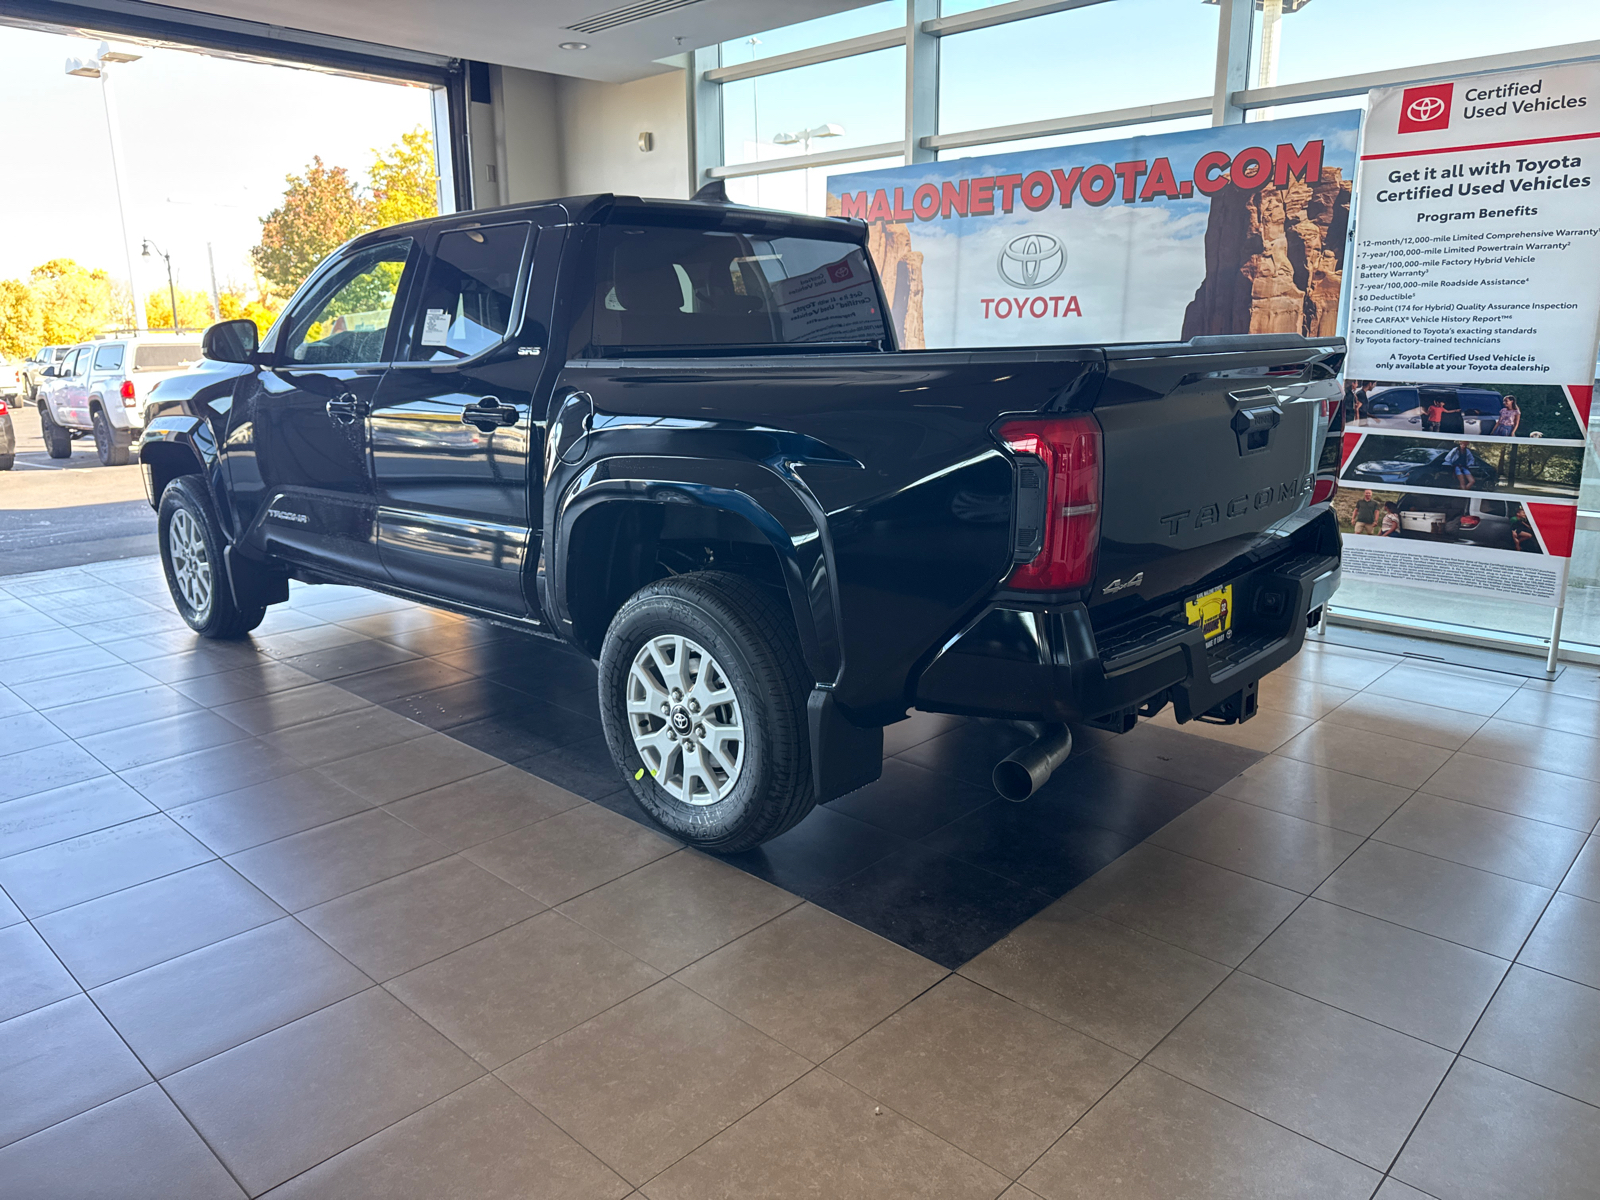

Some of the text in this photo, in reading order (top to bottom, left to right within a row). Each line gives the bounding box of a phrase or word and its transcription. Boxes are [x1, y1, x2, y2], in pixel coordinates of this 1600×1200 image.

[1465, 79, 1542, 102] Certified
[1463, 95, 1587, 119] Used Vehicles
[1388, 156, 1582, 184] Get it all with Toyota
[840, 139, 1325, 225] MALONETOYOTA.COM
[1376, 174, 1591, 203] Certified Used Vehicles
[1417, 206, 1538, 224] Program Benefits
[1362, 234, 1451, 247] 12-month/12,000-mile
[1452, 232, 1484, 242] Limited
[1485, 230, 1554, 240] Comprehensive
[1362, 247, 1442, 260] 7-year/100,000-mile
[1443, 245, 1475, 254] Limited
[1477, 243, 1524, 252] Powertrain
[1360, 255, 1536, 271] 8-year/100,000-mile Factory Hybrid Vehicle
[1360, 271, 1388, 279] Battery
[1359, 280, 1439, 291] 7-year/100,000-mile
[1440, 279, 1479, 287] Roadside
[1358, 294, 1368, 302] $0
[980, 296, 1082, 319] TOYOTA
[1394, 304, 1411, 313] (174
[1424, 303, 1455, 313] Hybrid)
[1456, 302, 1486, 312] Quality
[1532, 302, 1578, 311] Inspection
[1441, 315, 1471, 324] History
[1423, 327, 1455, 336] Toyota's
[1456, 327, 1492, 336] exacting
[1355, 336, 1364, 345] by
[1366, 336, 1391, 345] Toyota
[1392, 336, 1452, 345] factory-trained
[1389, 353, 1396, 361] A
[1398, 353, 1426, 361] Toyota
[1427, 353, 1467, 361] Certified
[1492, 354, 1526, 362] Vehicle
[1528, 354, 1536, 362] is
[1375, 362, 1394, 371] only
[1395, 362, 1437, 370] available
[1446, 364, 1466, 372] your
[1468, 363, 1498, 372] Toyota
[1499, 364, 1551, 373] dealership
[1160, 473, 1316, 538] TACOMA
[1102, 571, 1144, 595] 4x4
